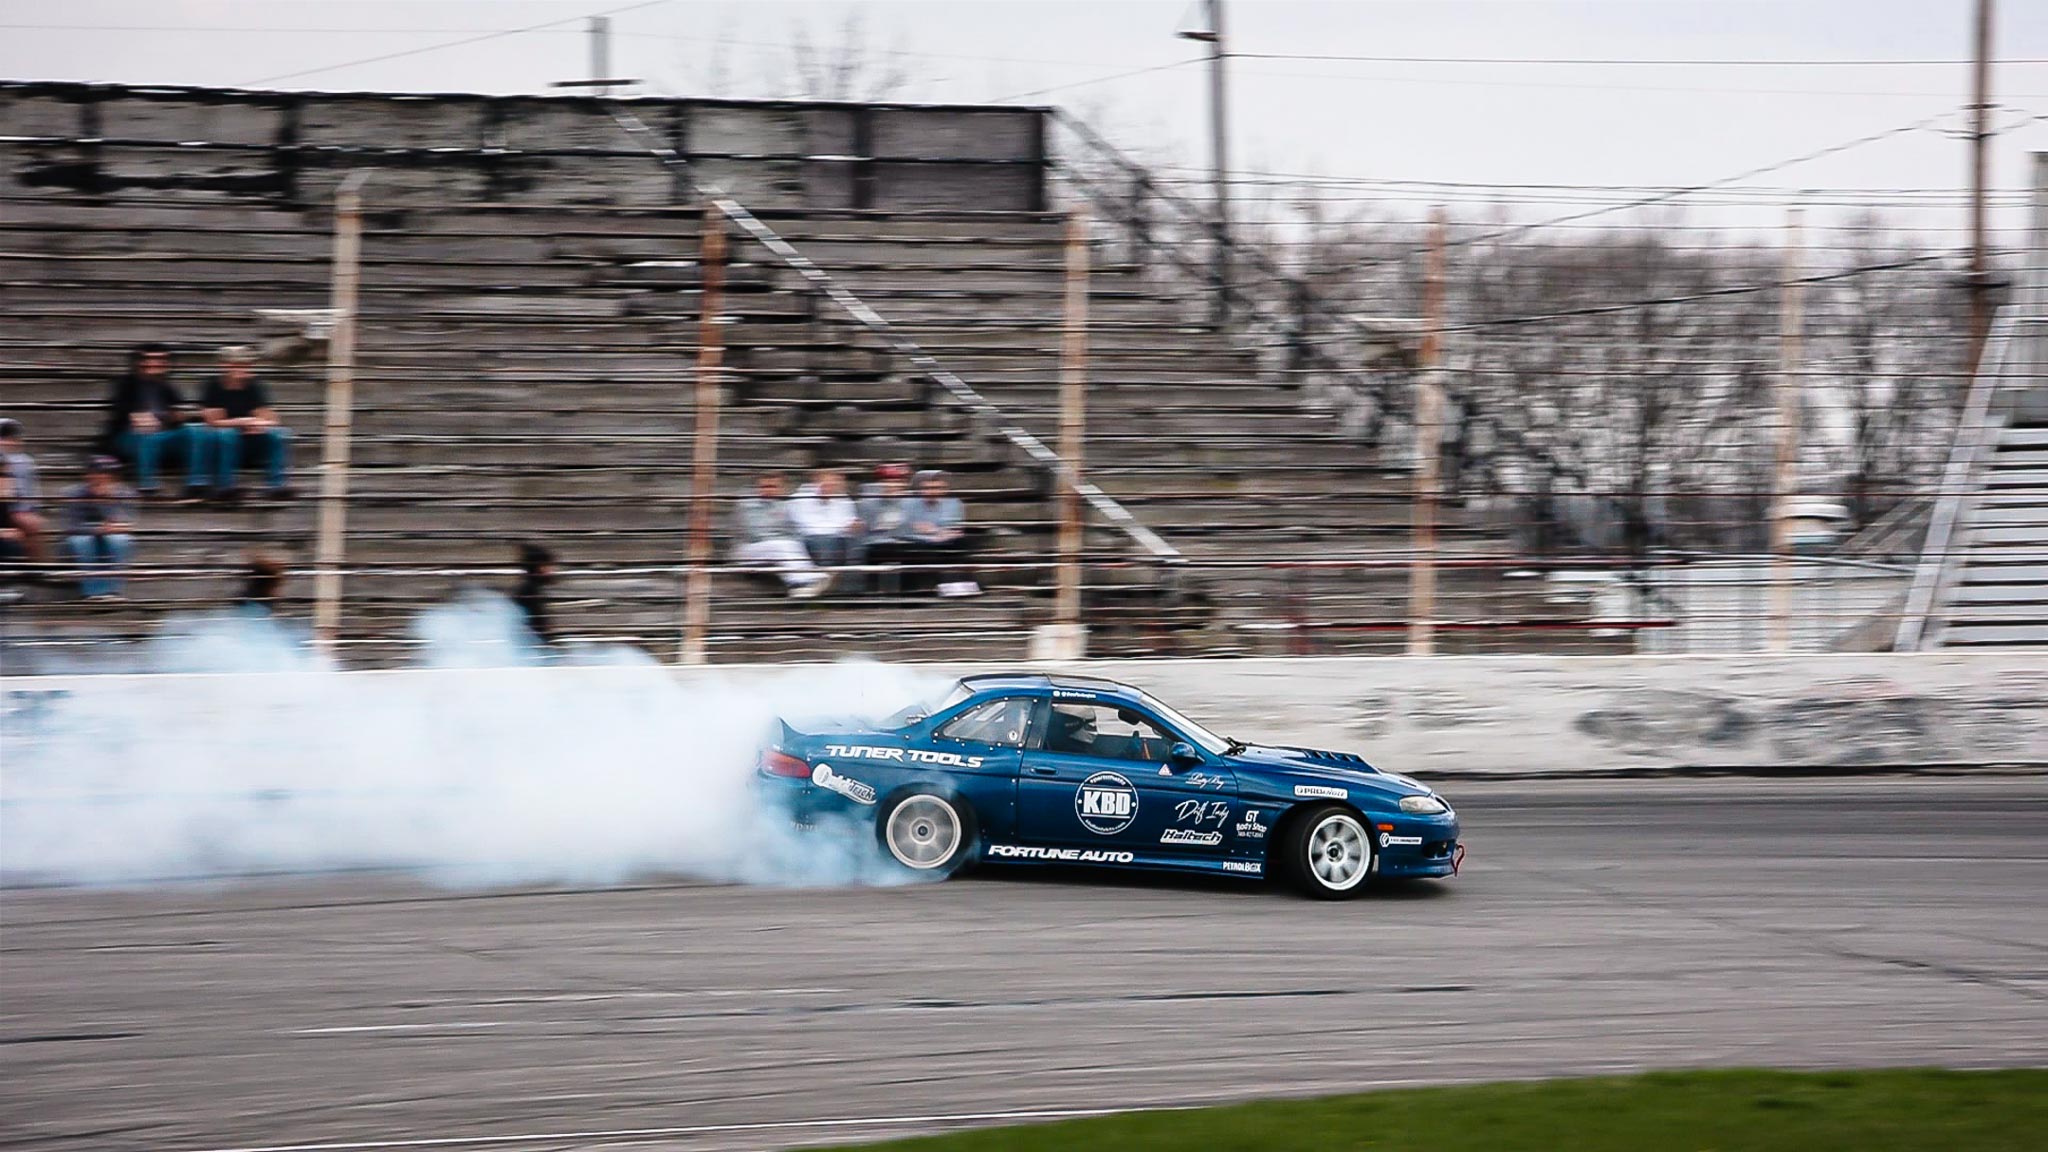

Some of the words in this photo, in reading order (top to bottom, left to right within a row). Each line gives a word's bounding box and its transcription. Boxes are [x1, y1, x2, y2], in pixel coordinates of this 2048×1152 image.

[825, 745, 904, 762] TUNER
[907, 750, 984, 768] TOOLS
[1083, 790, 1131, 815] KBD
[1175, 800, 1210, 825] Drift
[1206, 802, 1230, 829] Indy
[1245, 810, 1260, 822] GT
[1162, 830, 1222, 843] Haltech
[988, 845, 1080, 860] FORTUNE
[1080, 851, 1134, 862] AUTO
